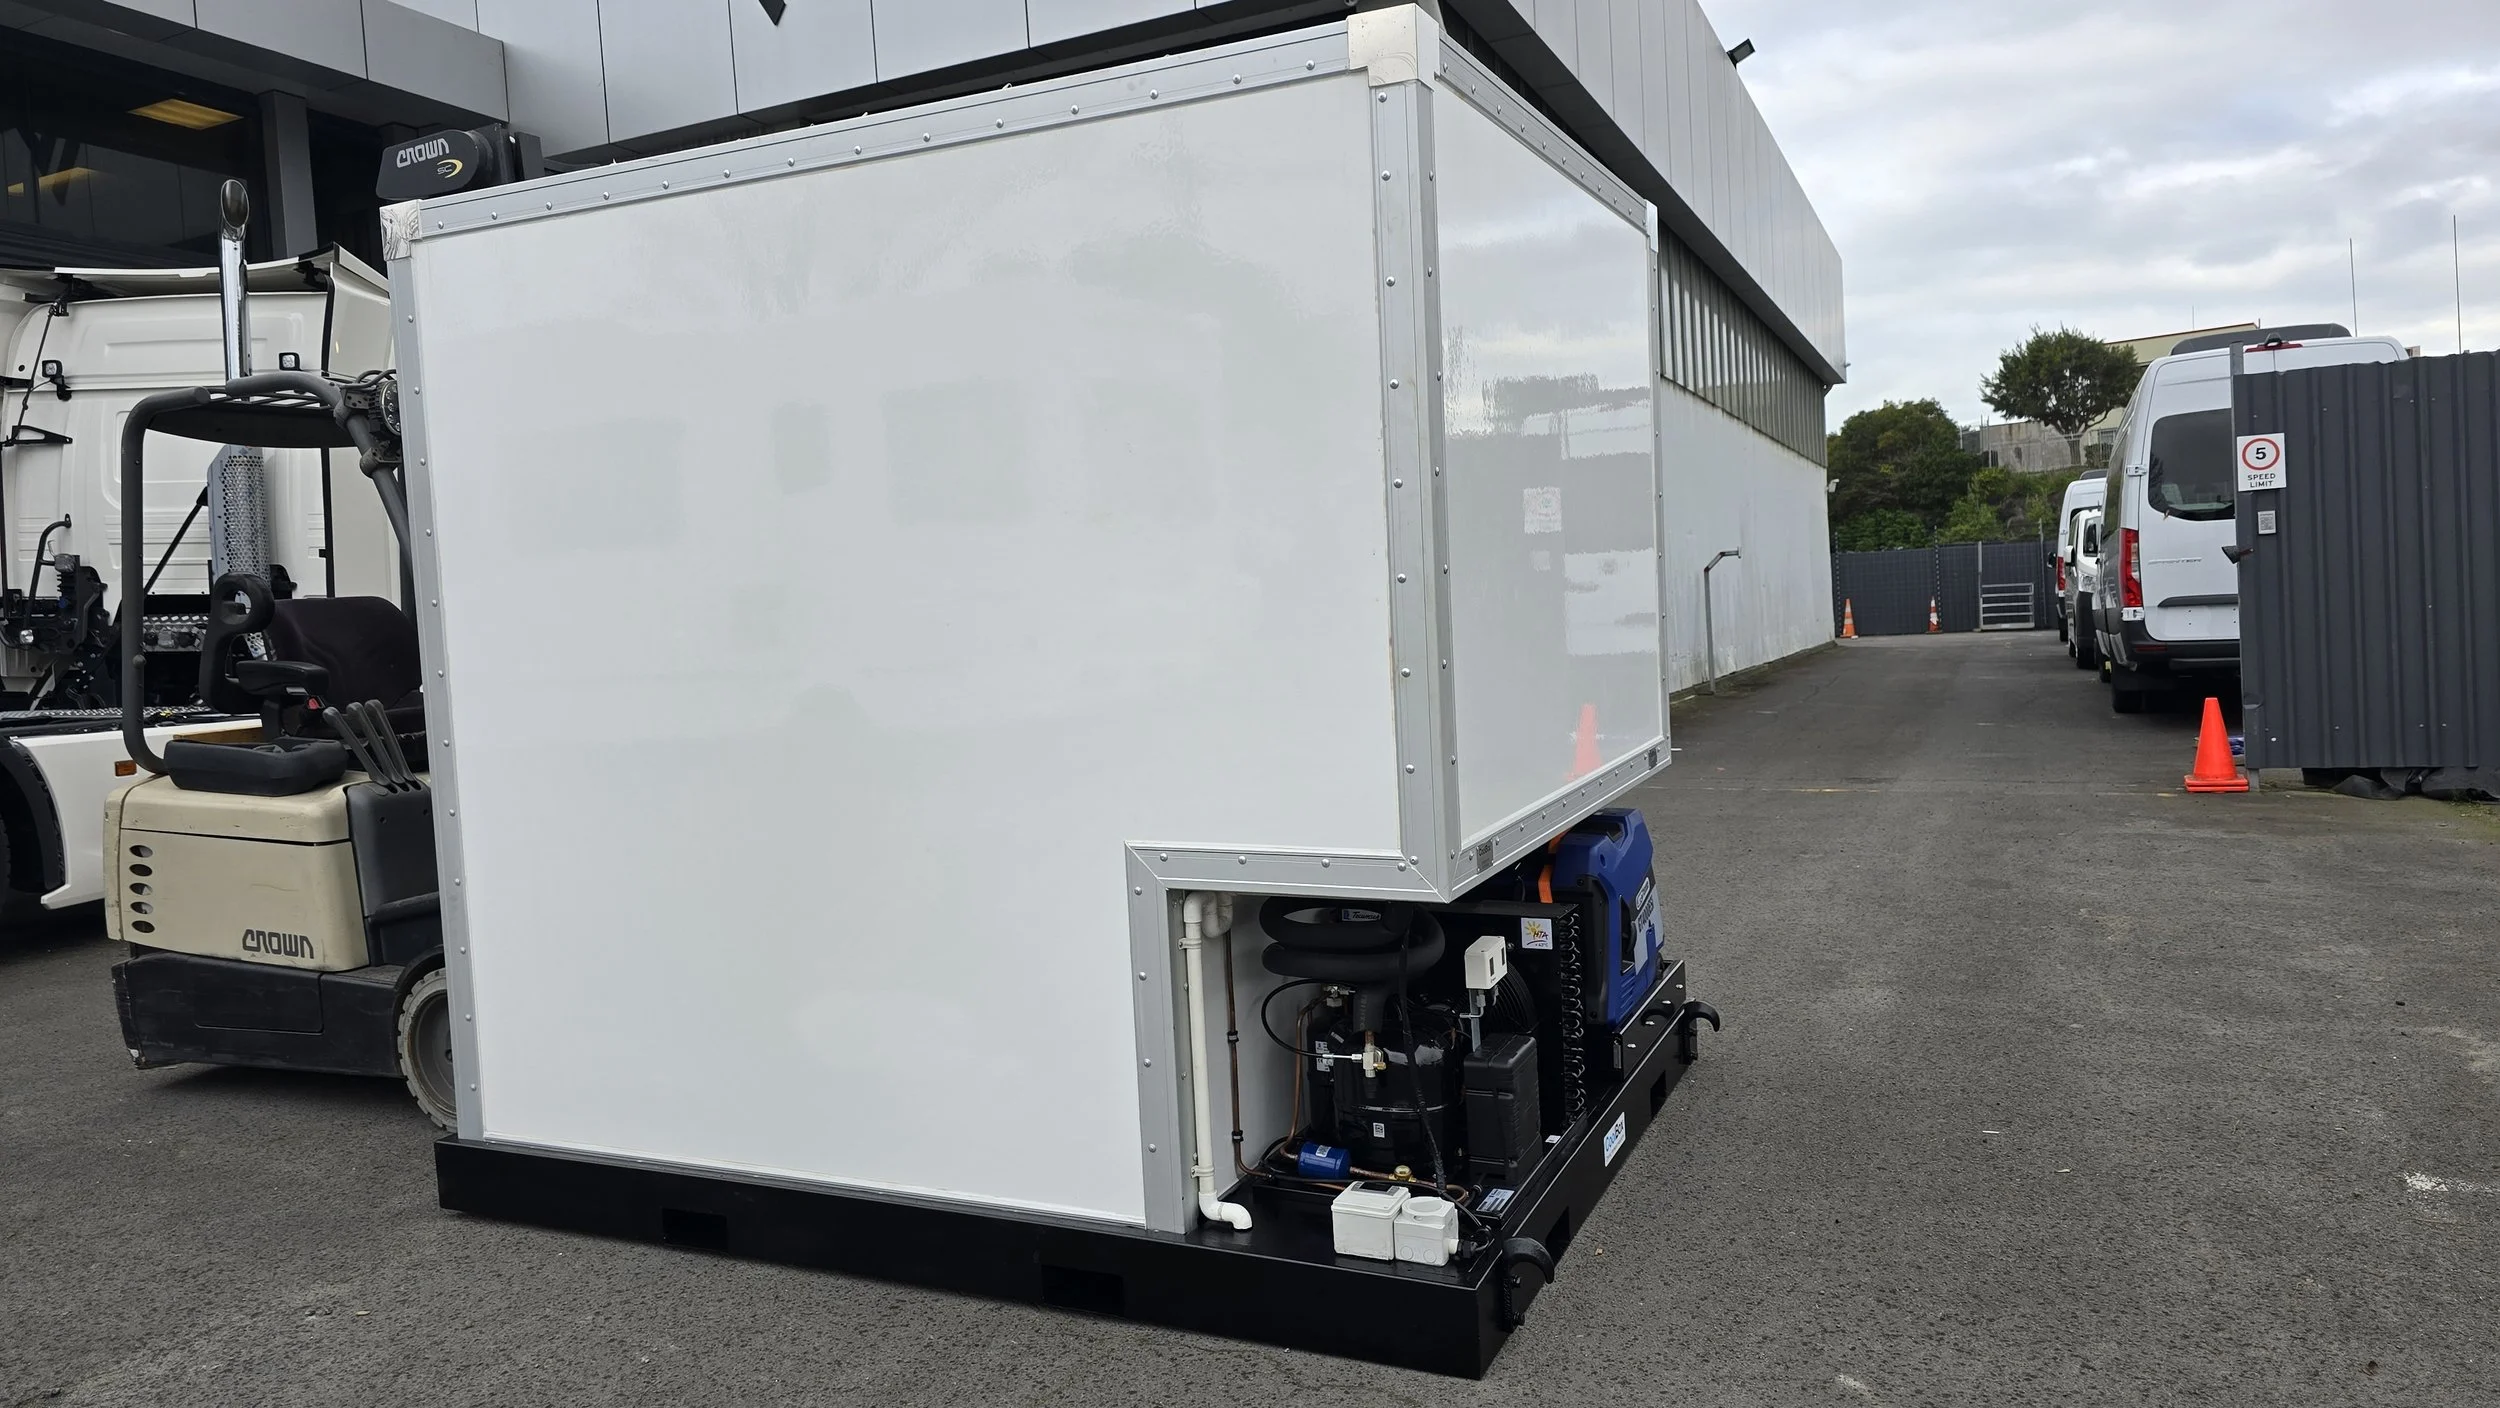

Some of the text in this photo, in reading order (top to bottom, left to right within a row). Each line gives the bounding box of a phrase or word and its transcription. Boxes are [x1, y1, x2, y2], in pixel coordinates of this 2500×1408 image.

[396, 137, 450, 168] CROWN
[2255, 447, 2267, 460] 5
[2247, 473, 2276, 481] SPEED
[2249, 480, 2274, 488] LIMIT
[242, 929, 315, 960] CROWN
